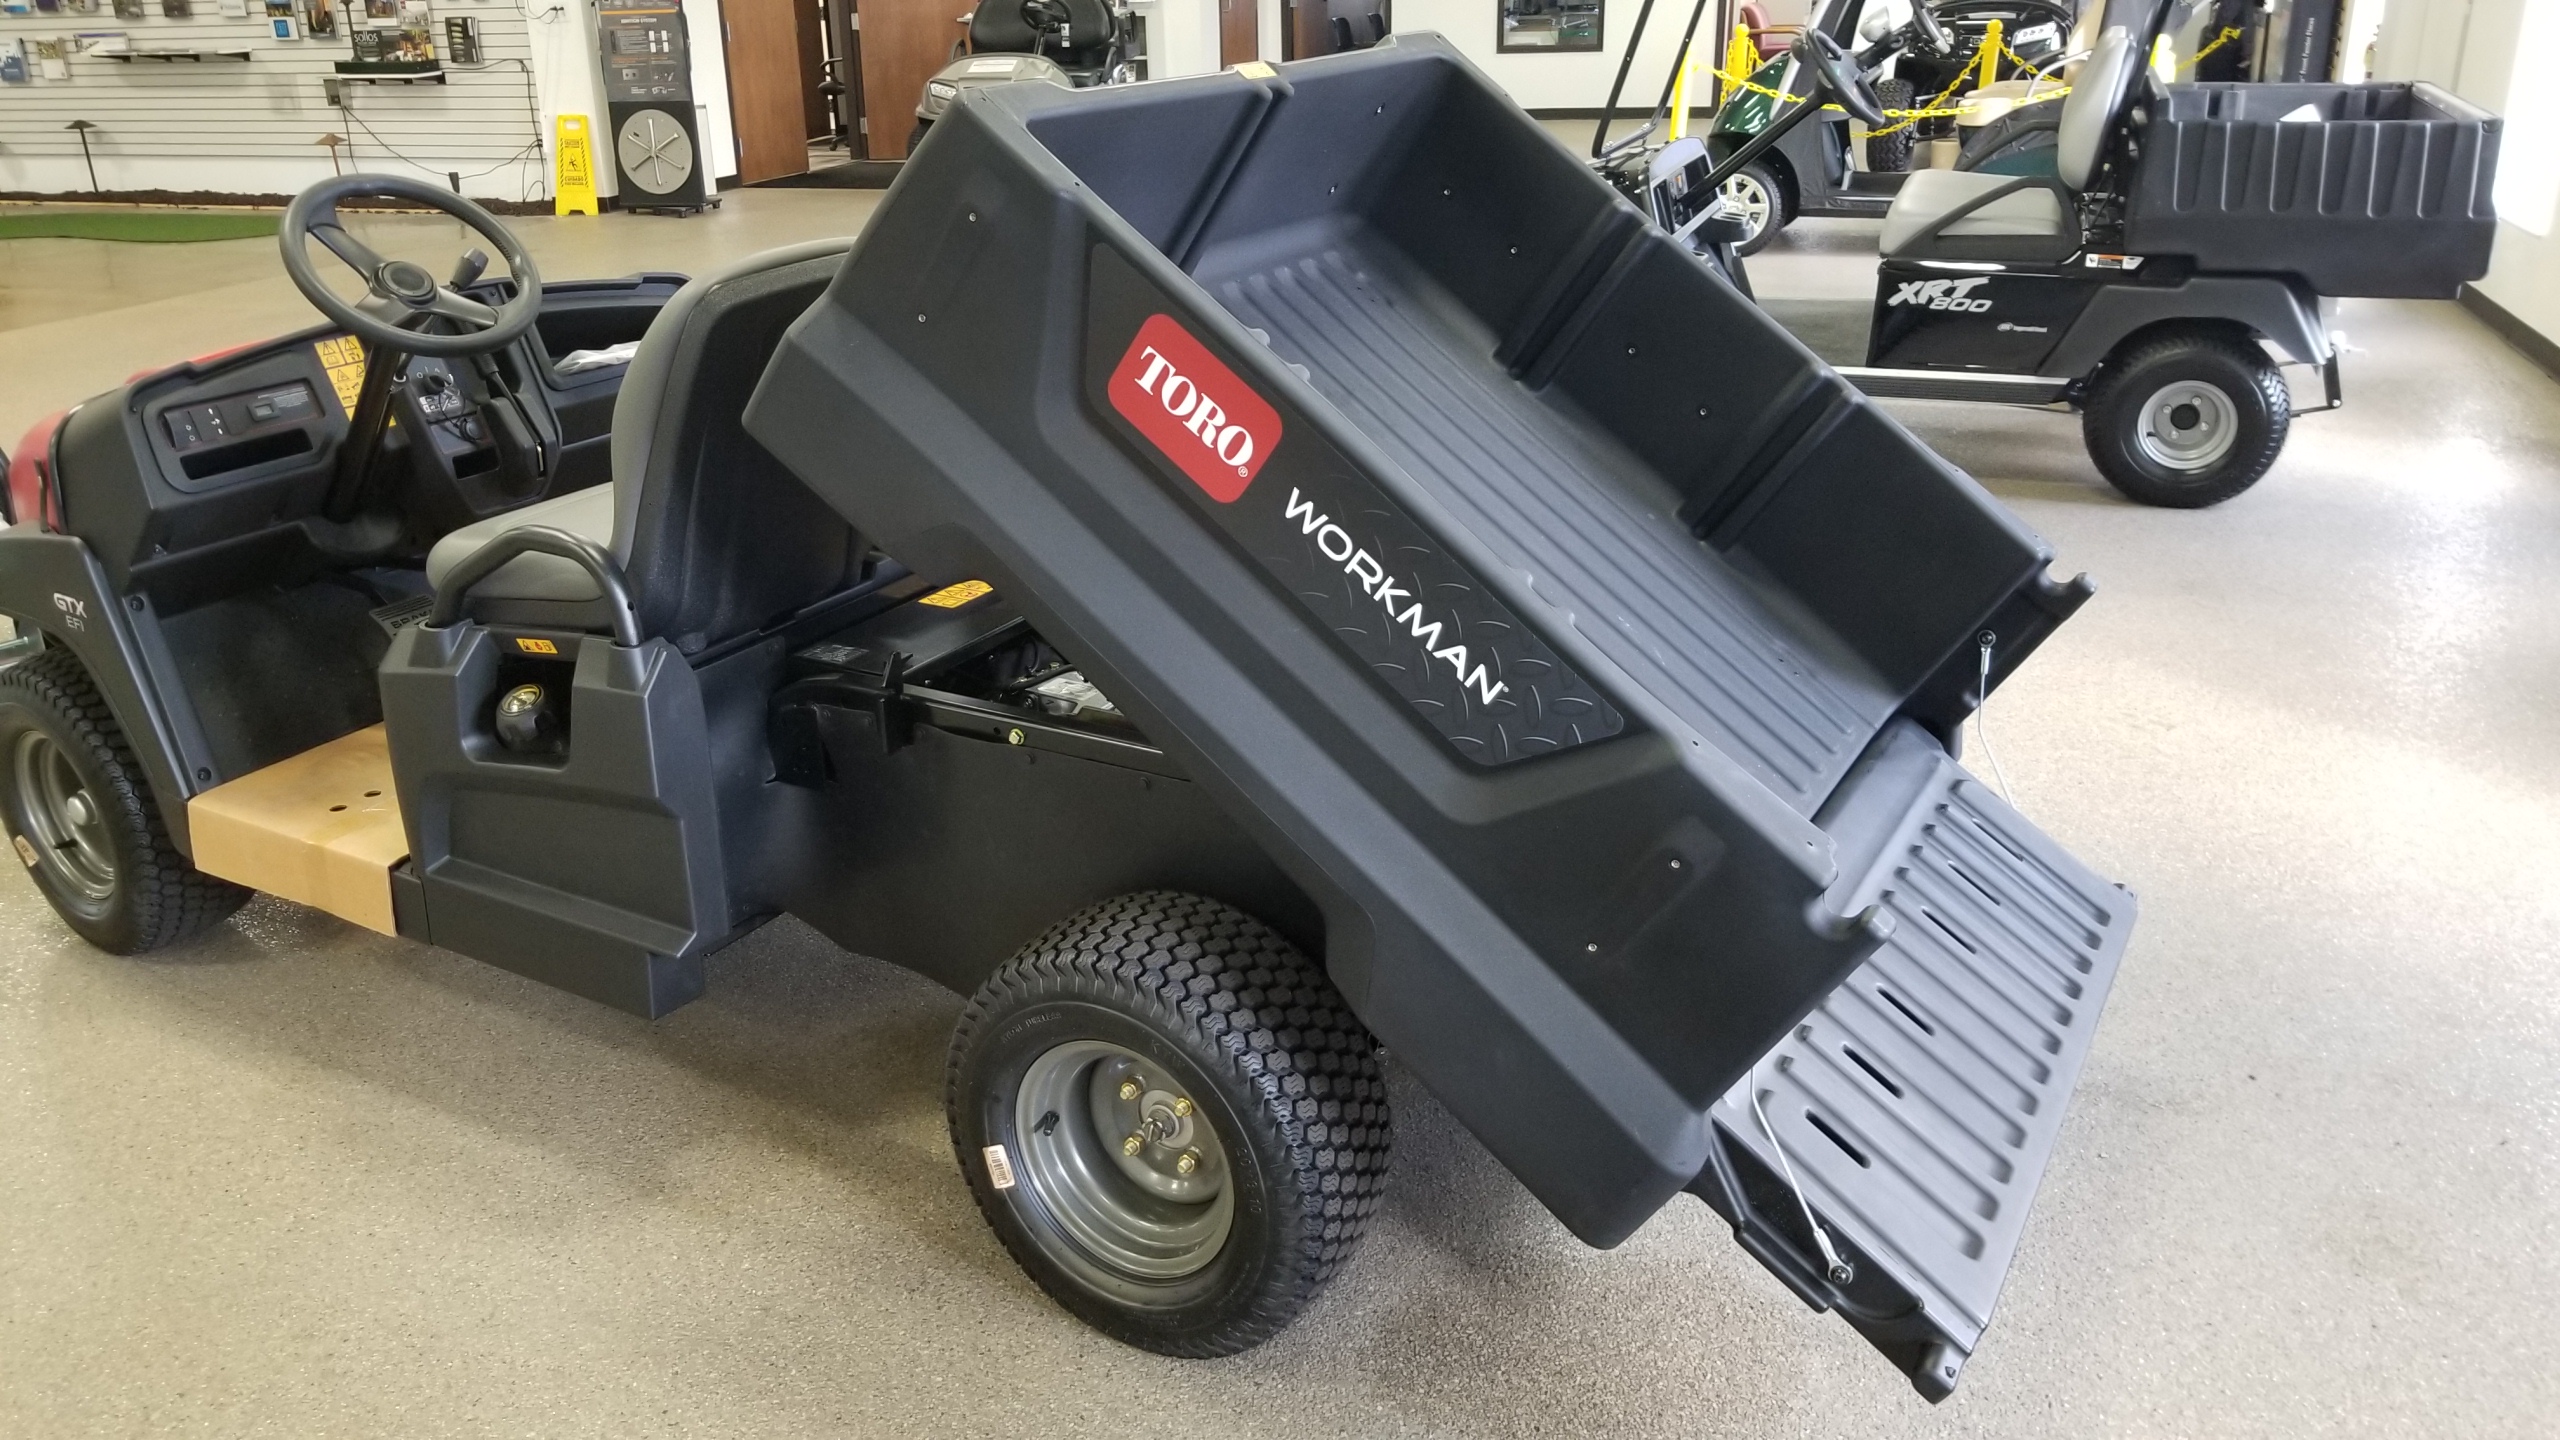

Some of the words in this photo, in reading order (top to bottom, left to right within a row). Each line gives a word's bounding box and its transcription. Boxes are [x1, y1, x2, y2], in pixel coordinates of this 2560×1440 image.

[1887, 276, 1991, 306] XRT
[1928, 296, 1993, 312] 800
[1134, 345, 1254, 466] TORO
[53, 592, 88, 618] GTX
[1285, 486, 1504, 705] WORKMAN
[65, 614, 85, 632] EFI
